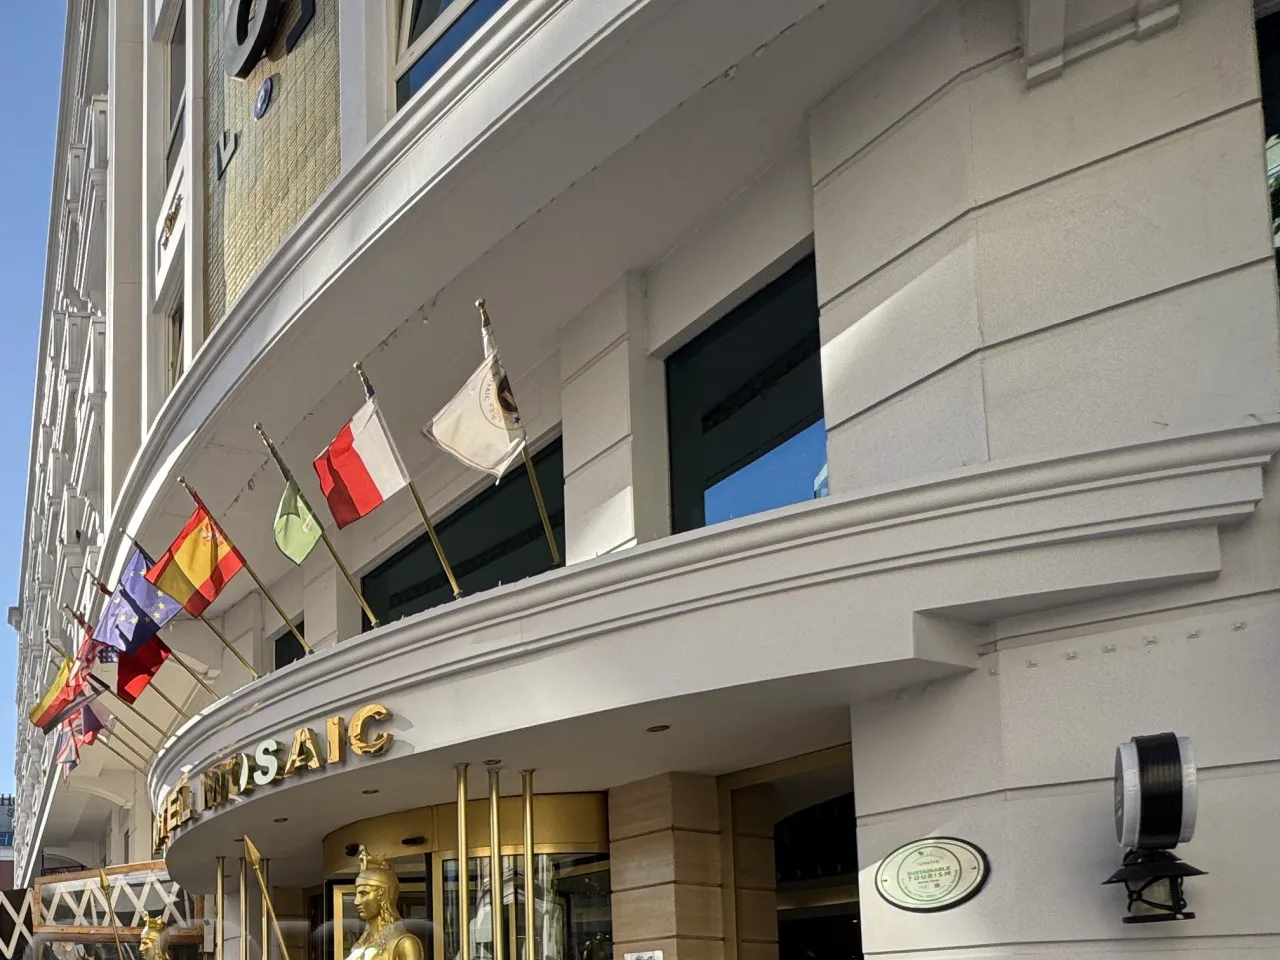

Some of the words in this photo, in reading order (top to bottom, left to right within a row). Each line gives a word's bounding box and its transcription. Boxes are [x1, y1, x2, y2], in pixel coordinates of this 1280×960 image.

[200, 703, 394, 811] MOSAIC
[906, 866, 951, 876] SUSTAINABLE
[907, 870, 952, 882] TOURISM
